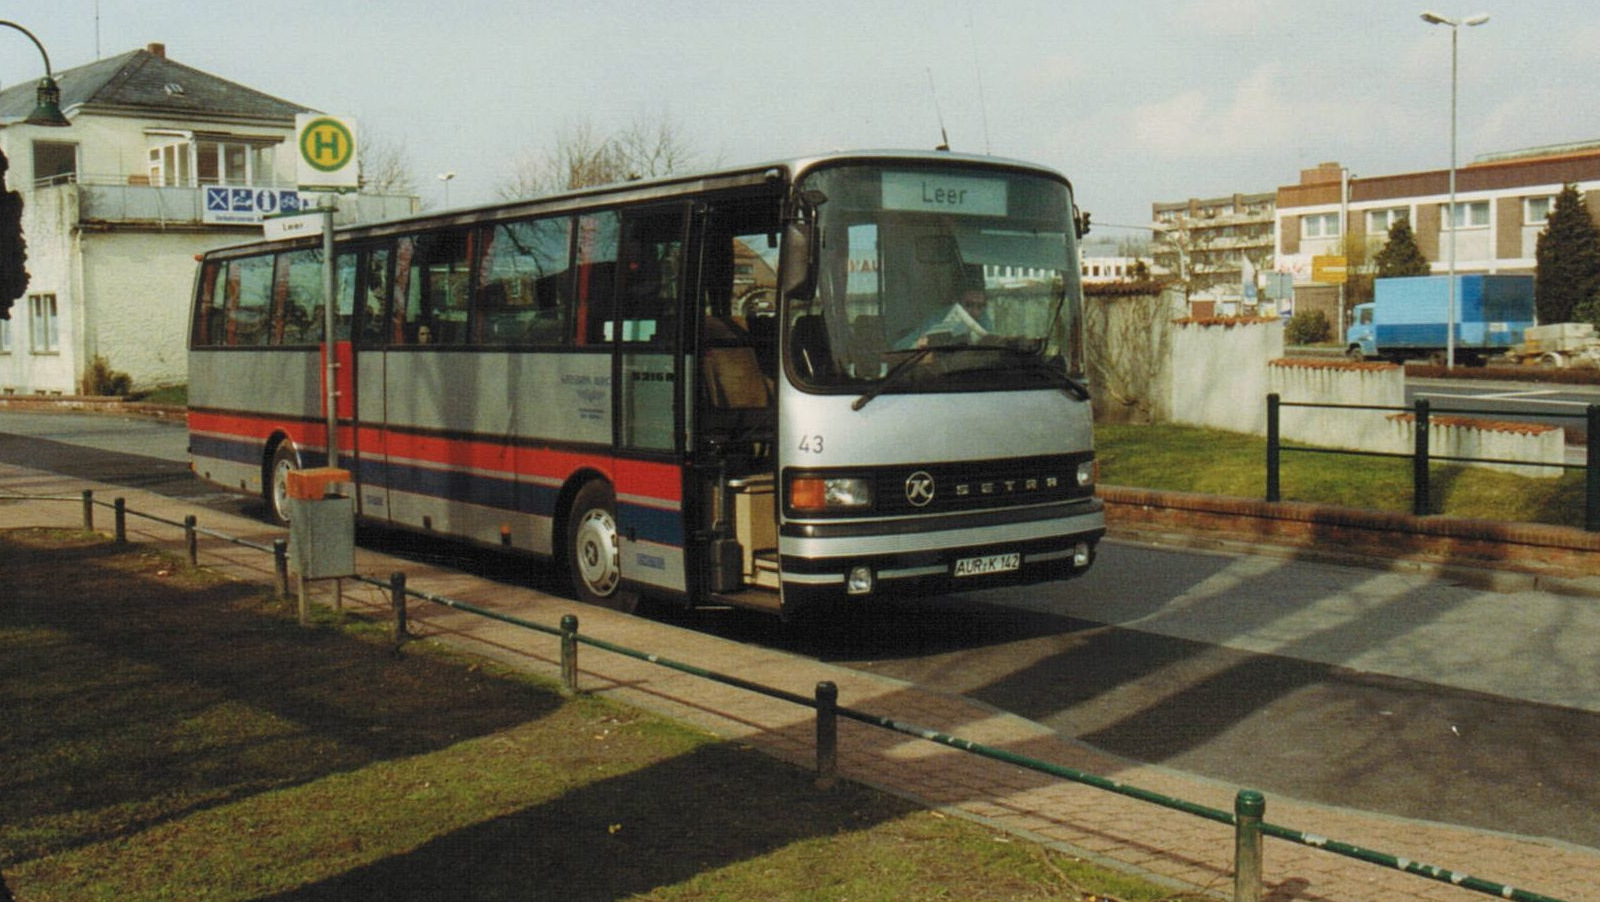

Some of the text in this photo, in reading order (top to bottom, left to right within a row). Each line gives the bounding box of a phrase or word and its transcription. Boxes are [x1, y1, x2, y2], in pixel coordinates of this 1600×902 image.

[314, 131, 339, 159] H
[921, 182, 968, 204] Leer
[282, 222, 304, 232] Leer
[798, 435, 824, 453] 43
[956, 477, 1057, 496] SETRA
[1000, 555, 1019, 569] 142
